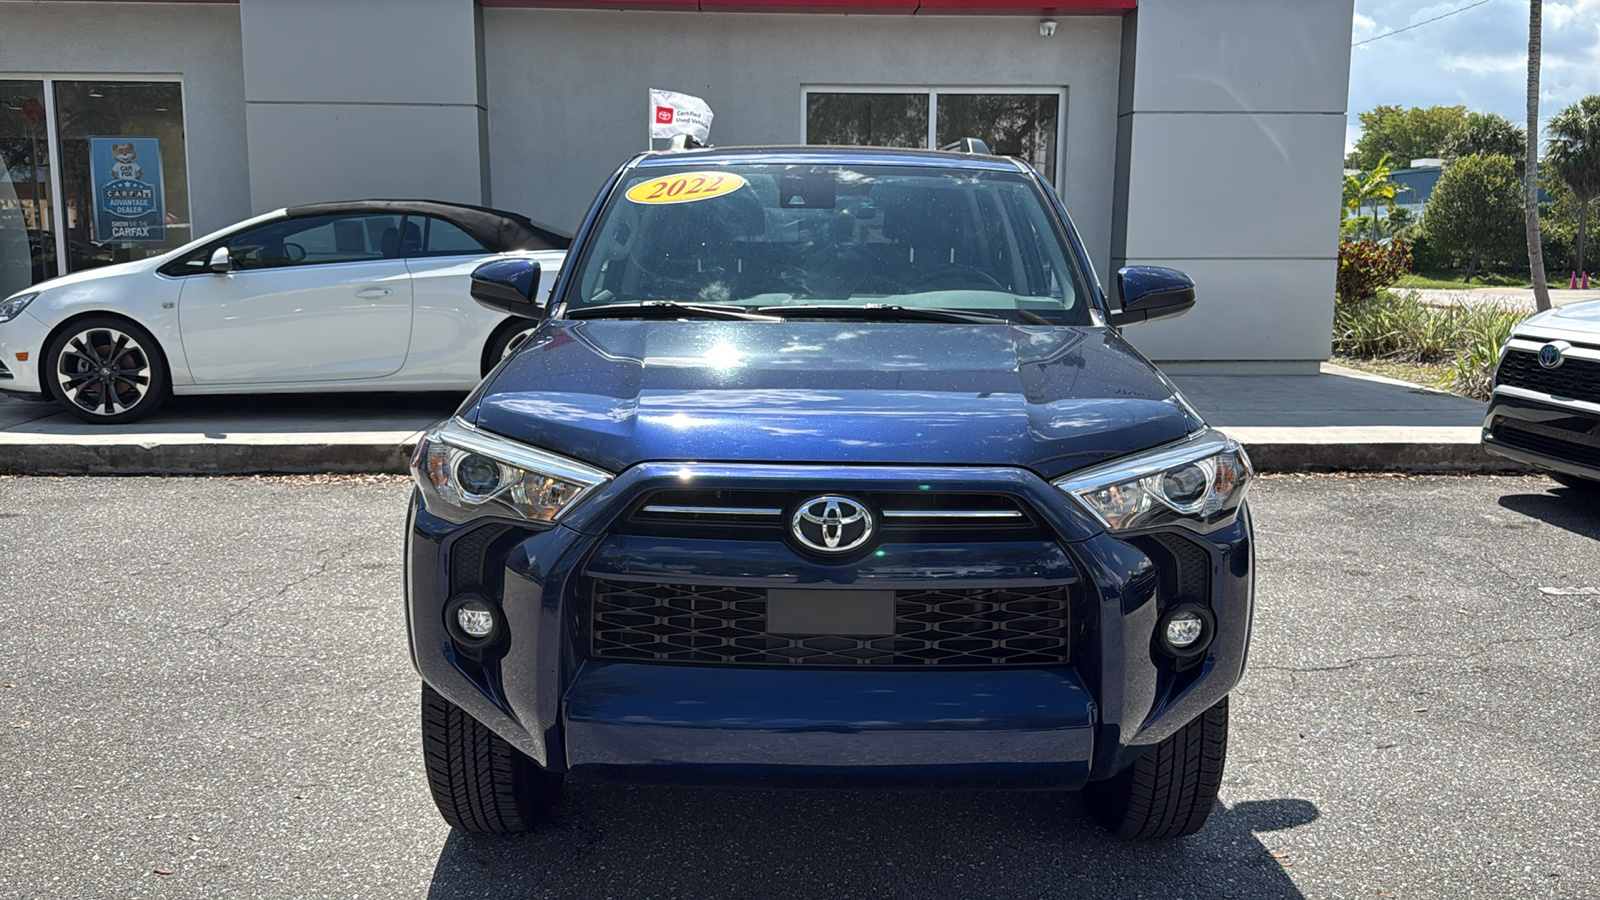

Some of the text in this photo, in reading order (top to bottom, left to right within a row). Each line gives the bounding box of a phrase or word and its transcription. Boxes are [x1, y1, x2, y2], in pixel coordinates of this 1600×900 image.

[645, 177, 724, 199] 2022
[107, 190, 151, 198] CARFAX
[112, 228, 149, 236] CARFAX
